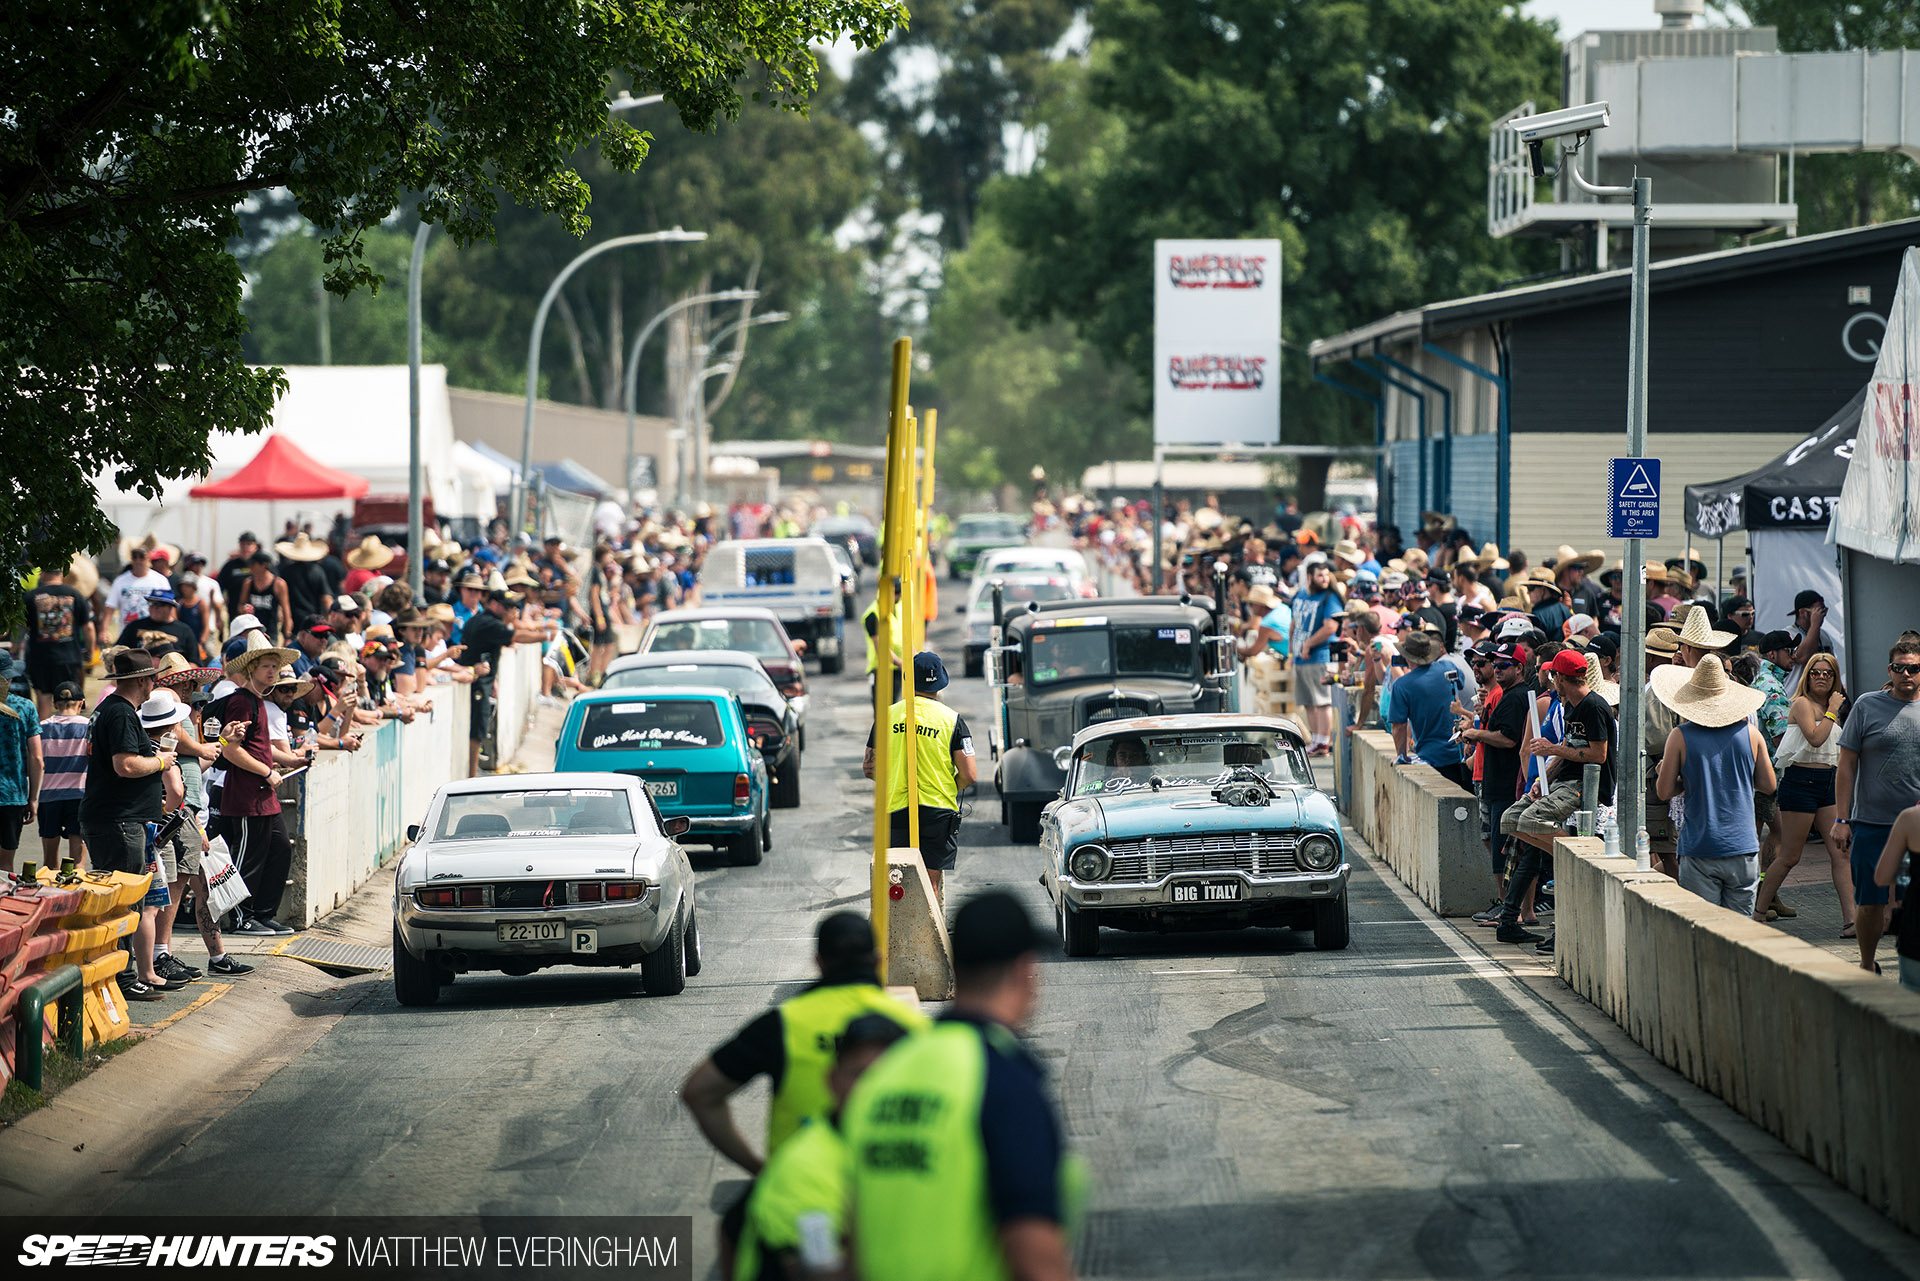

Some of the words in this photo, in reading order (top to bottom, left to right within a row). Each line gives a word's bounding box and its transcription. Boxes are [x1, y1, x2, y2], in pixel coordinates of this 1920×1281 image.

[1629, 509, 1641, 517] THIS
[1642, 509, 1655, 517] AREA
[593, 734, 618, 748] Work
[620, 729, 647, 742] Hard
[648, 728, 674, 740] Roll
[893, 722, 940, 739] SERITY
[1278, 740, 1290, 749] 30
[1174, 886, 1198, 901] BIG
[1204, 885, 1238, 900] ITALY
[576, 933, 591, 950] P
